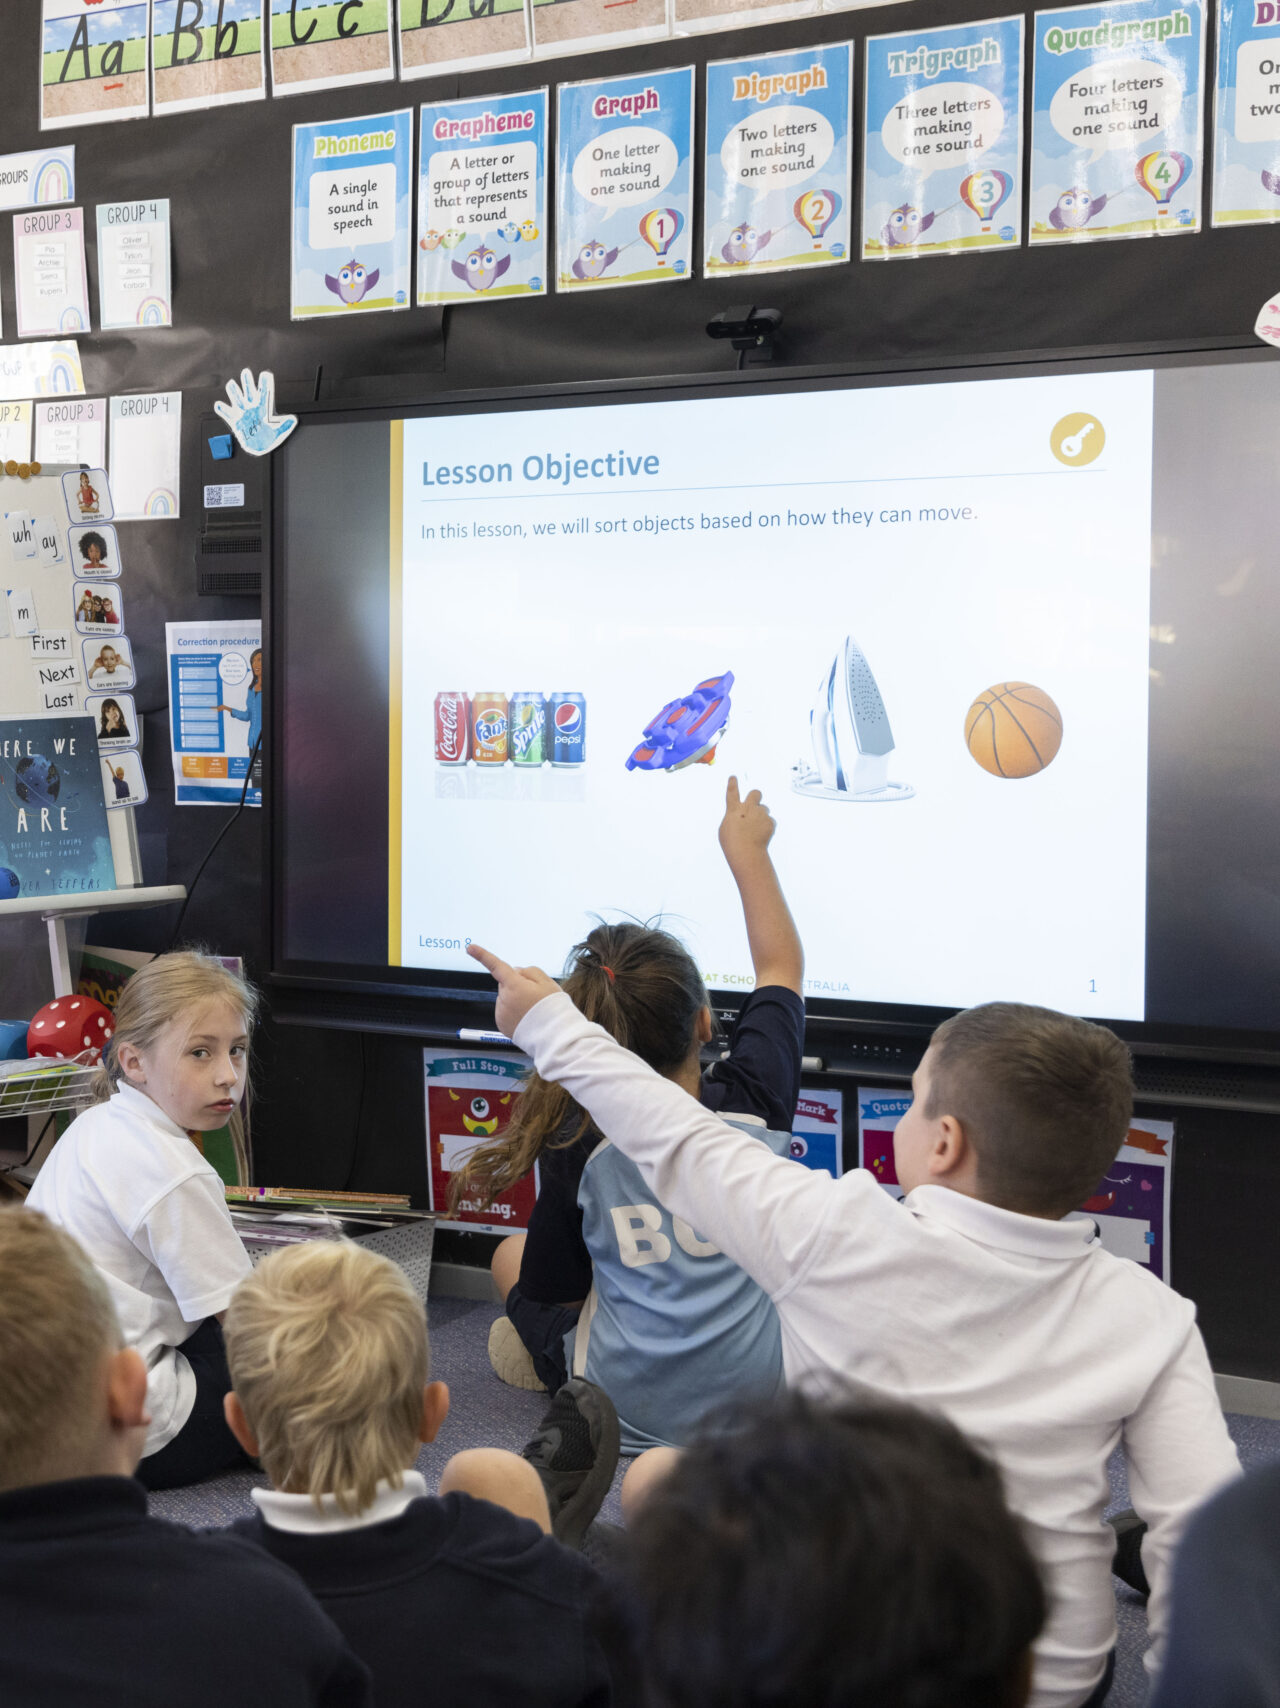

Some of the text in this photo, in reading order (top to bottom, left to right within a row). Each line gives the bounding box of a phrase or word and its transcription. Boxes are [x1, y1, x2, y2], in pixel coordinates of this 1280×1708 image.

[1046, 13, 1190, 53] Quadgraph
[890, 39, 999, 78] Trigraph
[735, 66, 825, 102] Digraph
[1070, 74, 1163, 99] Four letters
[594, 90, 659, 119] Graph
[896, 96, 991, 121] Three letters
[1084, 95, 1148, 119] making
[435, 111, 534, 140] Grapheme
[739, 120, 817, 142] Two letters
[913, 117, 973, 140] making
[1072, 113, 1160, 137] one sound
[315, 131, 395, 157] Phoneme
[592, 143, 660, 162] One letter
[751, 140, 805, 161] making
[903, 134, 984, 158] one sound
[450, 154, 514, 170] A letter or
[600, 162, 651, 179] making
[741, 156, 815, 178] one sound
[434, 169, 529, 194] group of letters
[1154, 162, 1172, 185] 4
[329, 180, 377, 198] A single
[434, 188, 528, 208] that represents
[590, 177, 660, 197] one sound
[981, 181, 994, 203] 3
[108, 204, 157, 224] GROUP 4
[328, 199, 378, 215] sound in
[457, 208, 507, 224] a sound
[811, 200, 824, 222] 2
[24, 213, 71, 233] GROUP 3
[333, 214, 373, 233] speech
[657, 219, 664, 239] 1
[423, 450, 659, 486] Lesson Objective
[13, 521, 31, 543] wh
[421, 506, 978, 539] In this lesson, we will sort objects based on how they can move.
[42, 534, 57, 557] ay
[32, 635, 66, 650] First
[177, 637, 260, 648] Correction procedure
[39, 665, 75, 684] Next
[45, 692, 74, 709] Last
[512, 709, 546, 755] Sprite
[554, 734, 581, 745] pepsi
[54, 738, 76, 756] WE
[17, 807, 68, 833] ARE
[419, 935, 461, 949] Lesson
[1089, 978, 1097, 993] 1
[452, 1060, 506, 1075] Full Stop
[797, 1101, 826, 1116] Mark
